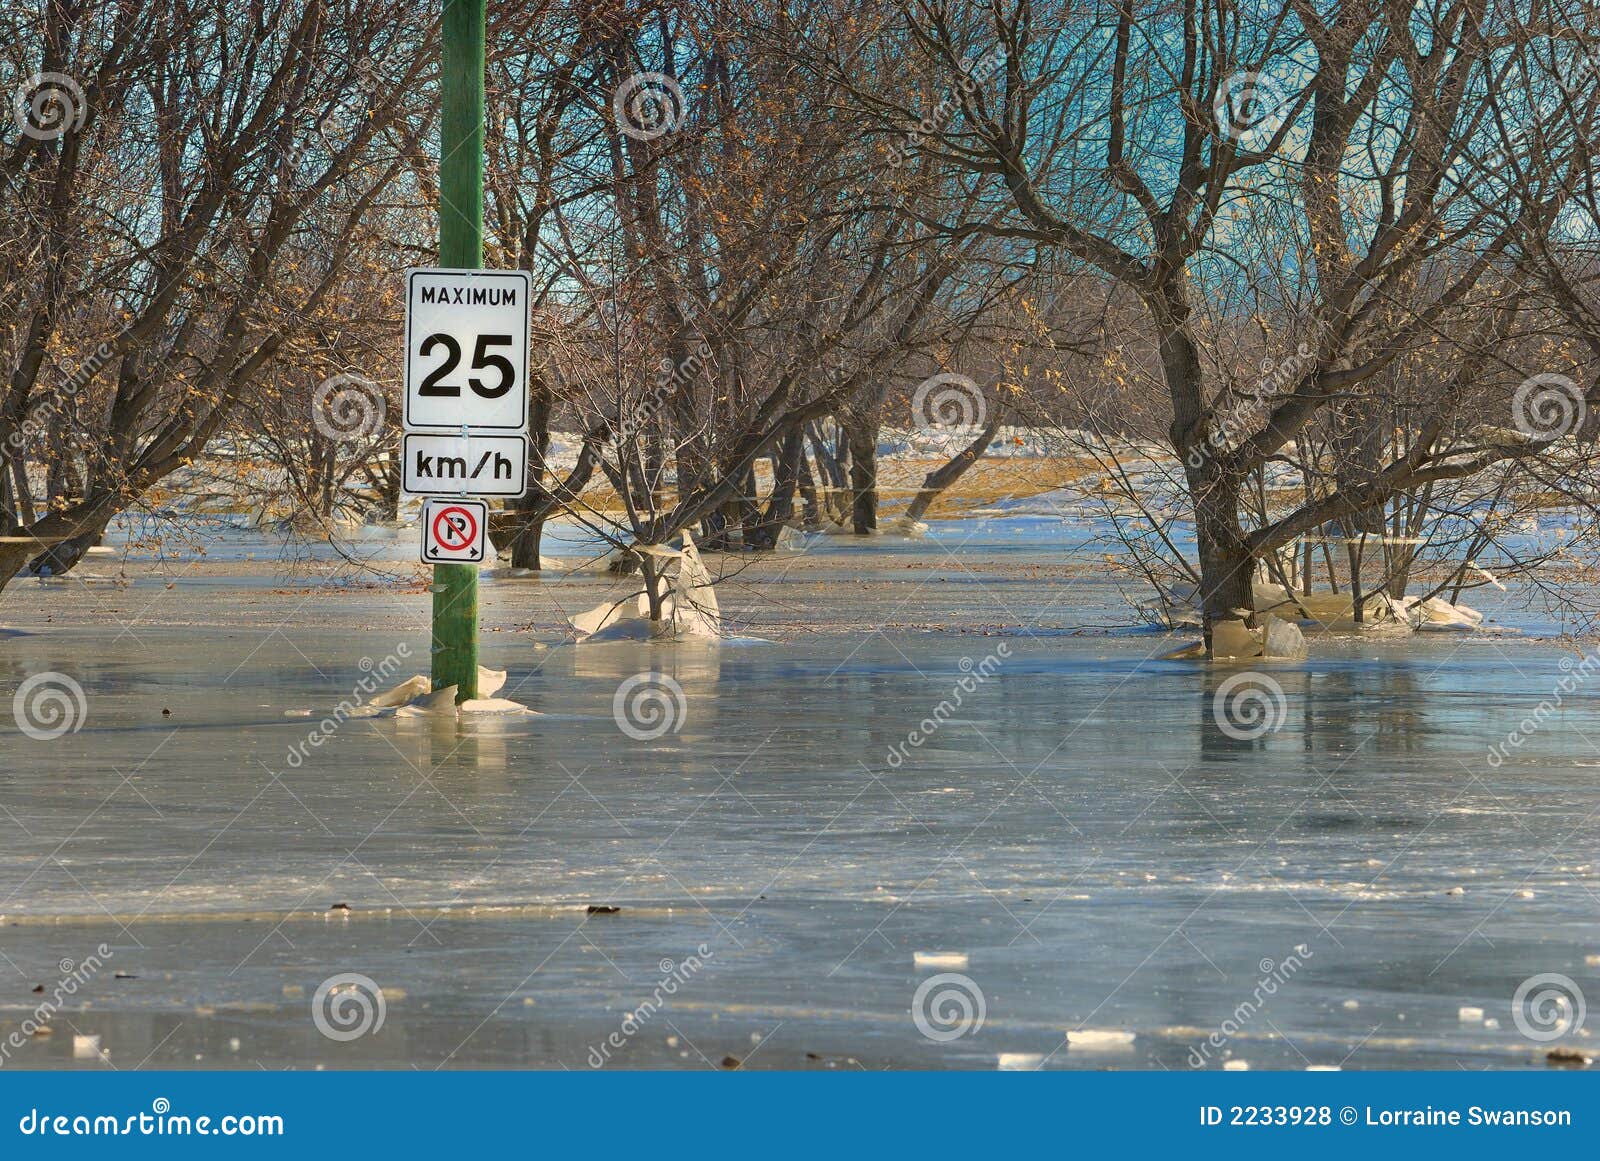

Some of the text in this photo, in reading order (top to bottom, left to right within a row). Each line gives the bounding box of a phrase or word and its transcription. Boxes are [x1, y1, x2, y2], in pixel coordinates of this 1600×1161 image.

[421, 286, 516, 306] MAXIMUM
[418, 333, 516, 399] 25
[416, 450, 512, 480] km/h
